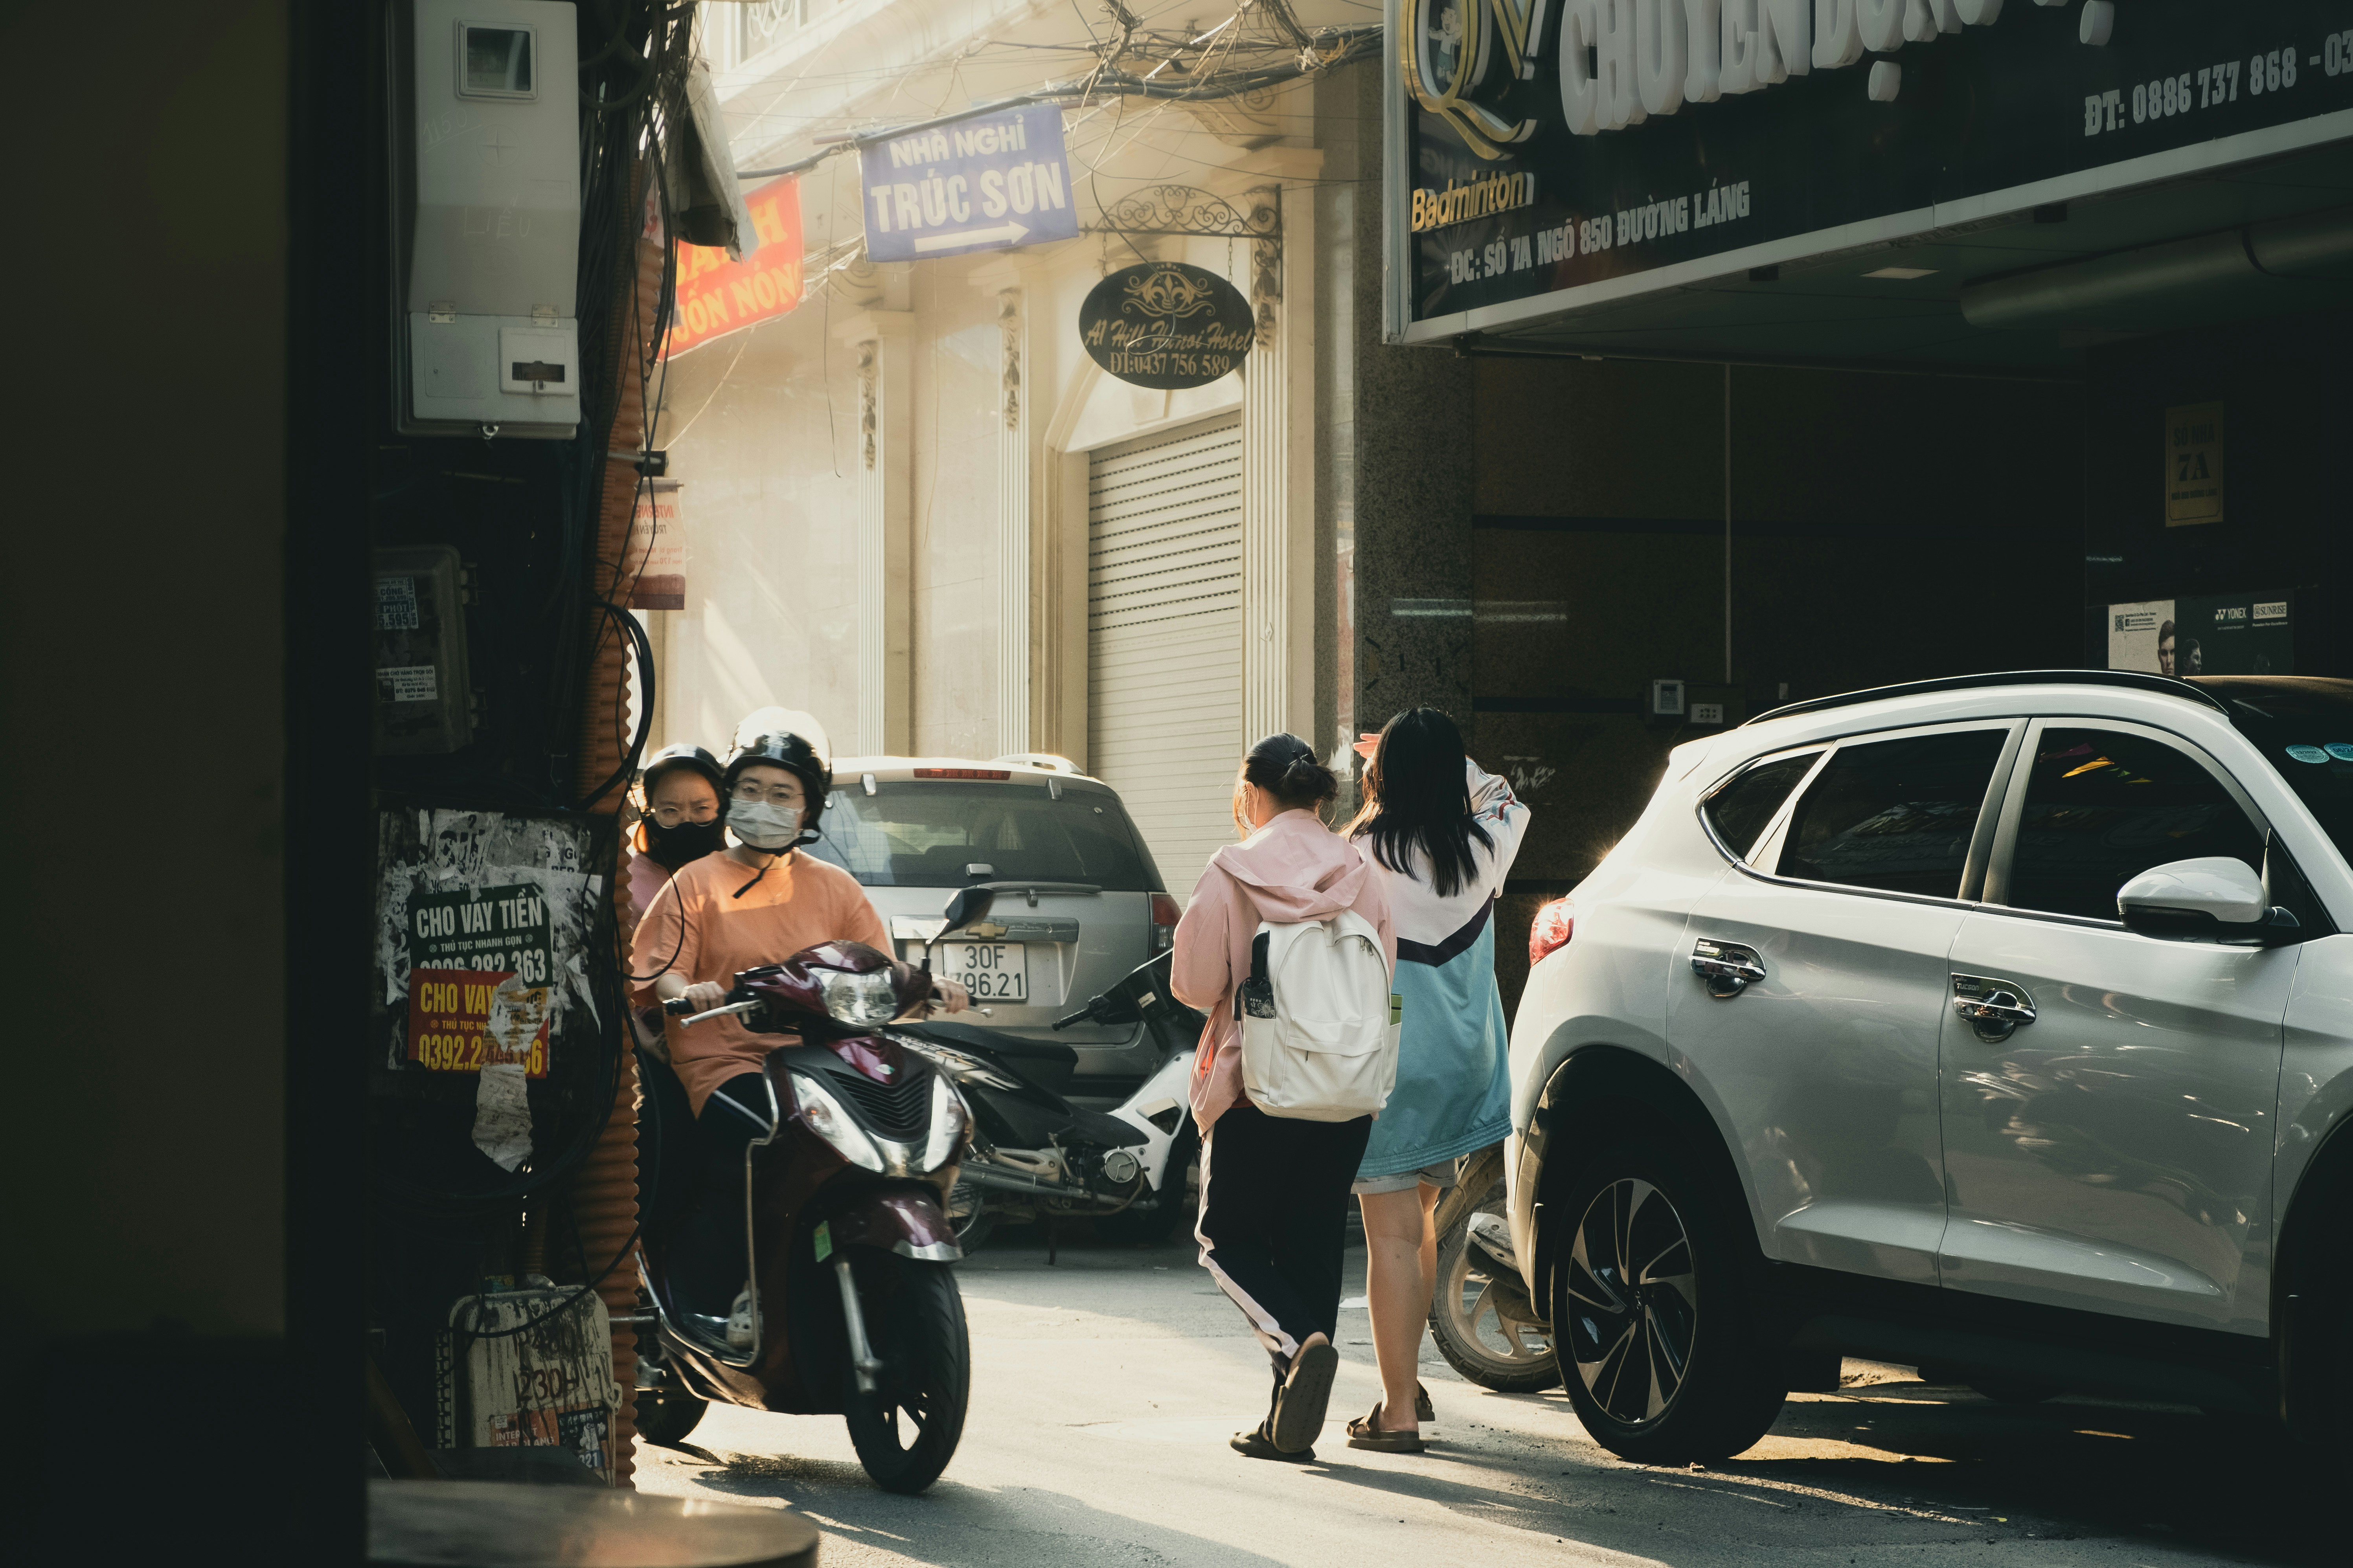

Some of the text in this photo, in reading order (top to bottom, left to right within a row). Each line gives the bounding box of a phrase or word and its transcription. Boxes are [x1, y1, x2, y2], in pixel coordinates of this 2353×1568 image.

[2085, 89, 2125, 136] ĐT:
[2133, 73, 2191, 123] 0886
[2198, 61, 2240, 108] 737
[2250, 46, 2296, 95] 868
[889, 114, 1026, 168] NHÀ NGHỈ
[870, 161, 1066, 233] TRÚC SƠN
[1411, 170, 1527, 233] Badminton
[1451, 177, 1750, 285] ĐC: SỐ 7A NGÕ 850 ĐƯỜNG LÁNG
[1110, 319, 1146, 348] Hill
[1171, 353, 1197, 376] 756
[1202, 355, 1230, 376] 589
[2178, 450, 2211, 481] 7A
[2227, 608, 2246, 619] YONEX
[2261, 605, 2286, 616] SUNRISE
[416, 887, 542, 938] CHO VAY TIỀN
[440, 935, 522, 953] THỦ TỤC NHANH GỌN
[965, 945, 1006, 969] 30F
[511, 948, 546, 983] 363
[420, 982, 498, 1014] CHO VAY
[442, 1018, 457, 1030] THỦ
[460, 1021, 475, 1032] TỤC
[496, 1427, 537, 1441] INTERT
